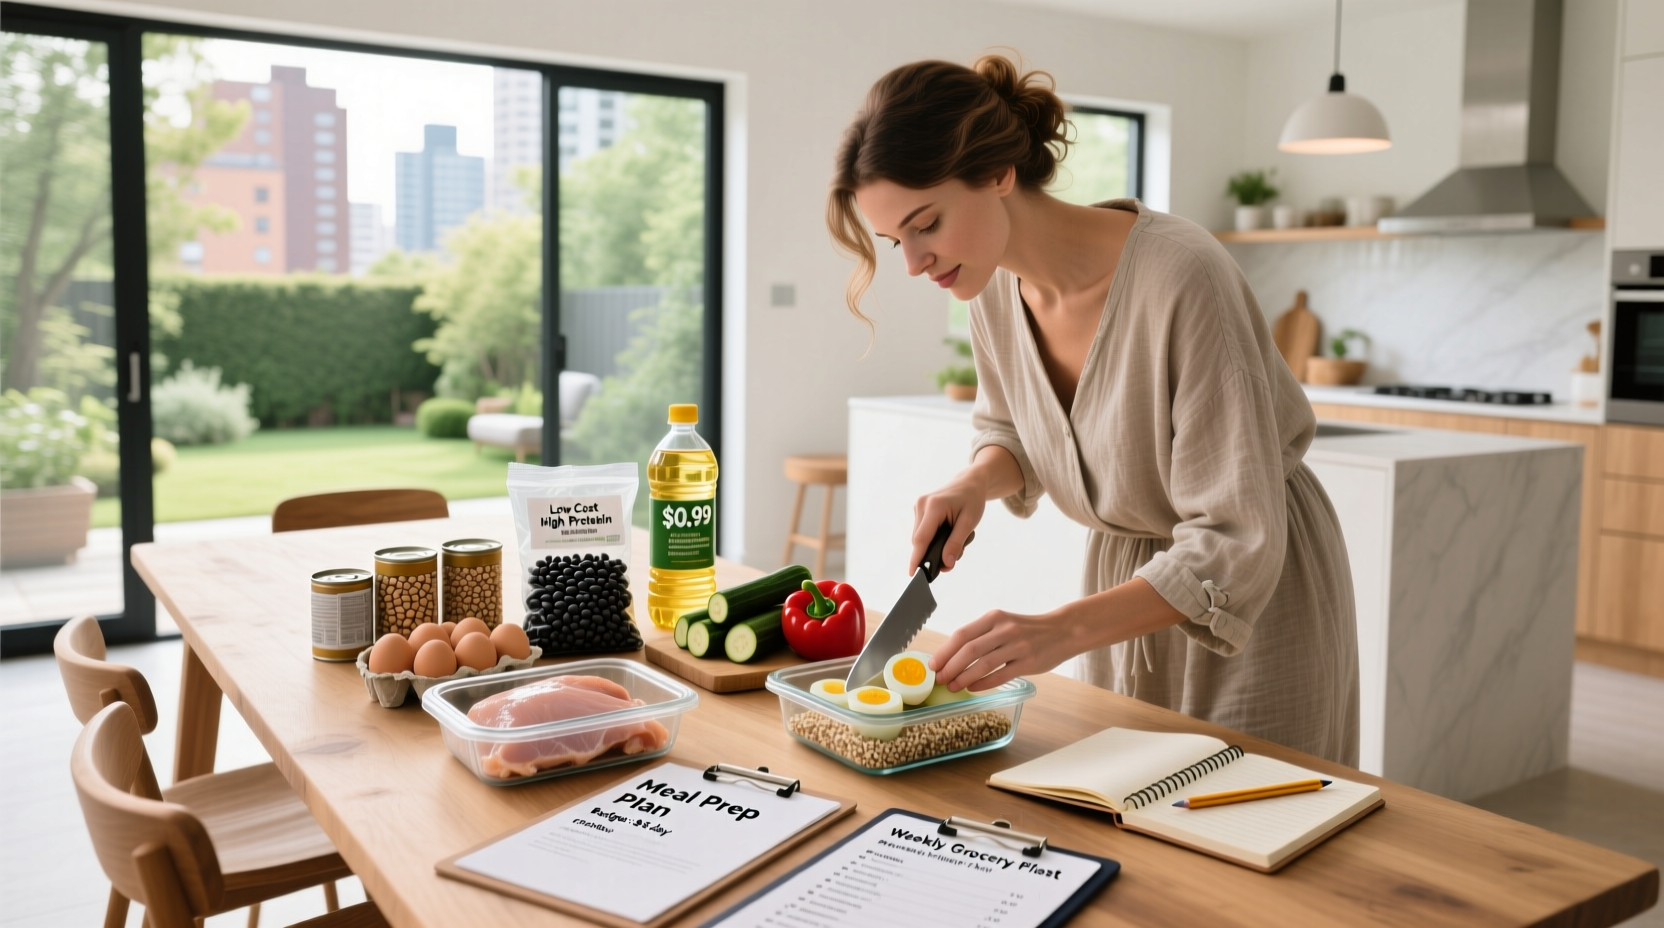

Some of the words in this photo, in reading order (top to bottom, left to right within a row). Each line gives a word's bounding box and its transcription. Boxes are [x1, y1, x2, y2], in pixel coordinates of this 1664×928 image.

[549, 504, 571, 514] Low
[662, 504, 712, 530] $0.99
[612, 793, 671, 818] Plan
[636, 779, 702, 804] Meal
[699, 795, 760, 821] Prep
[951, 843, 1015, 870] Grocery
